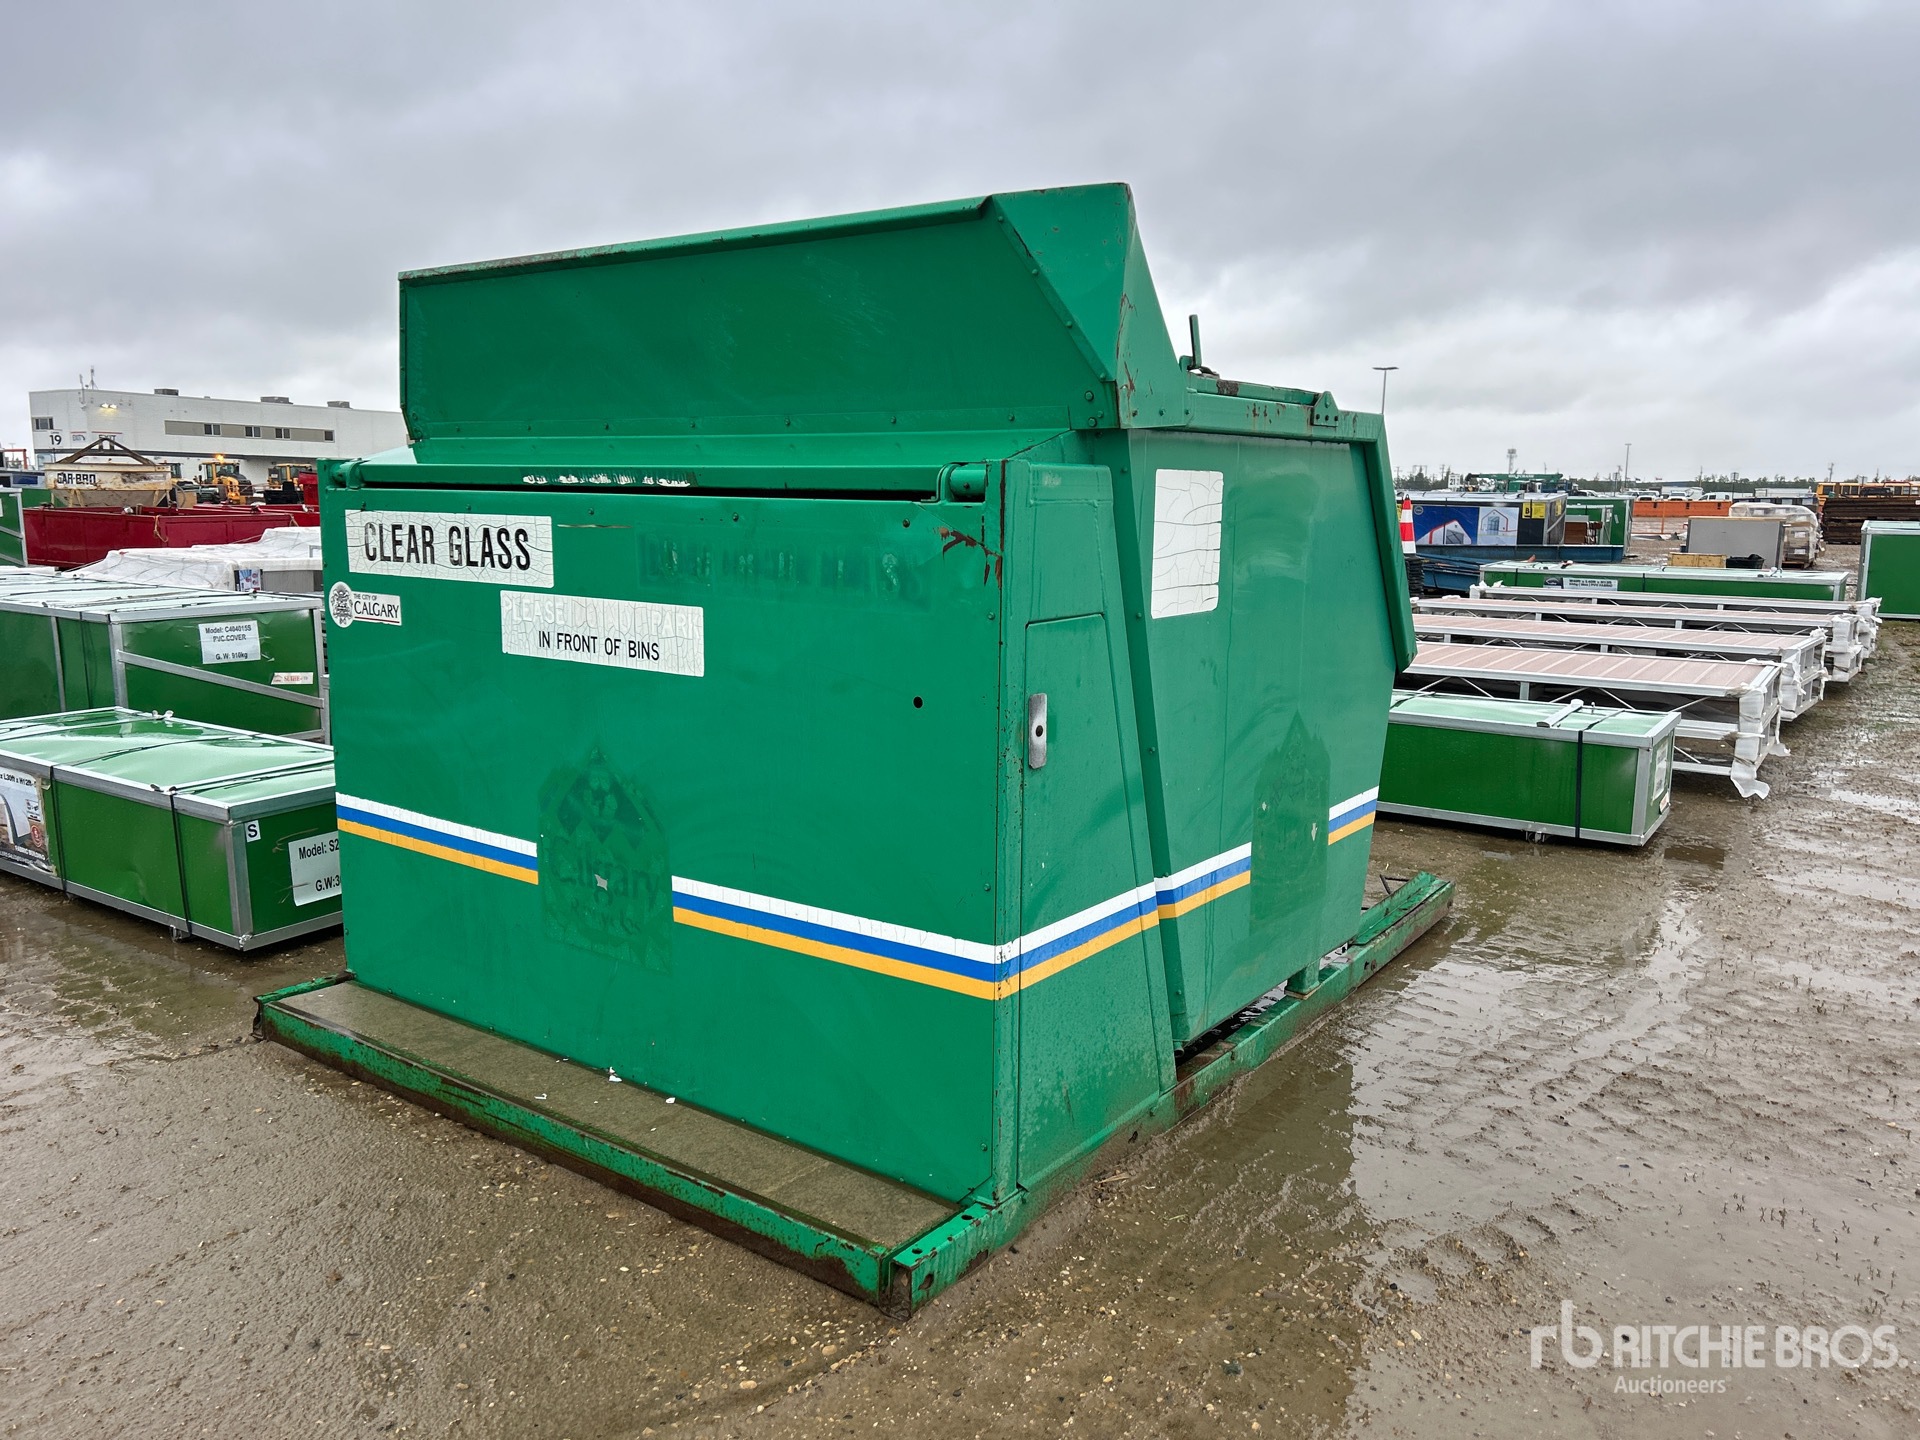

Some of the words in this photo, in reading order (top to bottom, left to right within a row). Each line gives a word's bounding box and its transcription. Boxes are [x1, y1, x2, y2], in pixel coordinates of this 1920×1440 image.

[49, 434, 62, 446] 19
[364, 521, 436, 565] CLEAR
[448, 525, 531, 571] GLASS
[354, 600, 399, 619] CALGARY
[205, 626, 224, 634] Model:
[538, 630, 550, 648] IN
[557, 632, 598, 653] FRONT
[604, 637, 621, 656] OF
[628, 640, 660, 661] BINS
[247, 823, 258, 838] S
[298, 842, 327, 860] Model:
[315, 874, 341, 892] G.W:3
